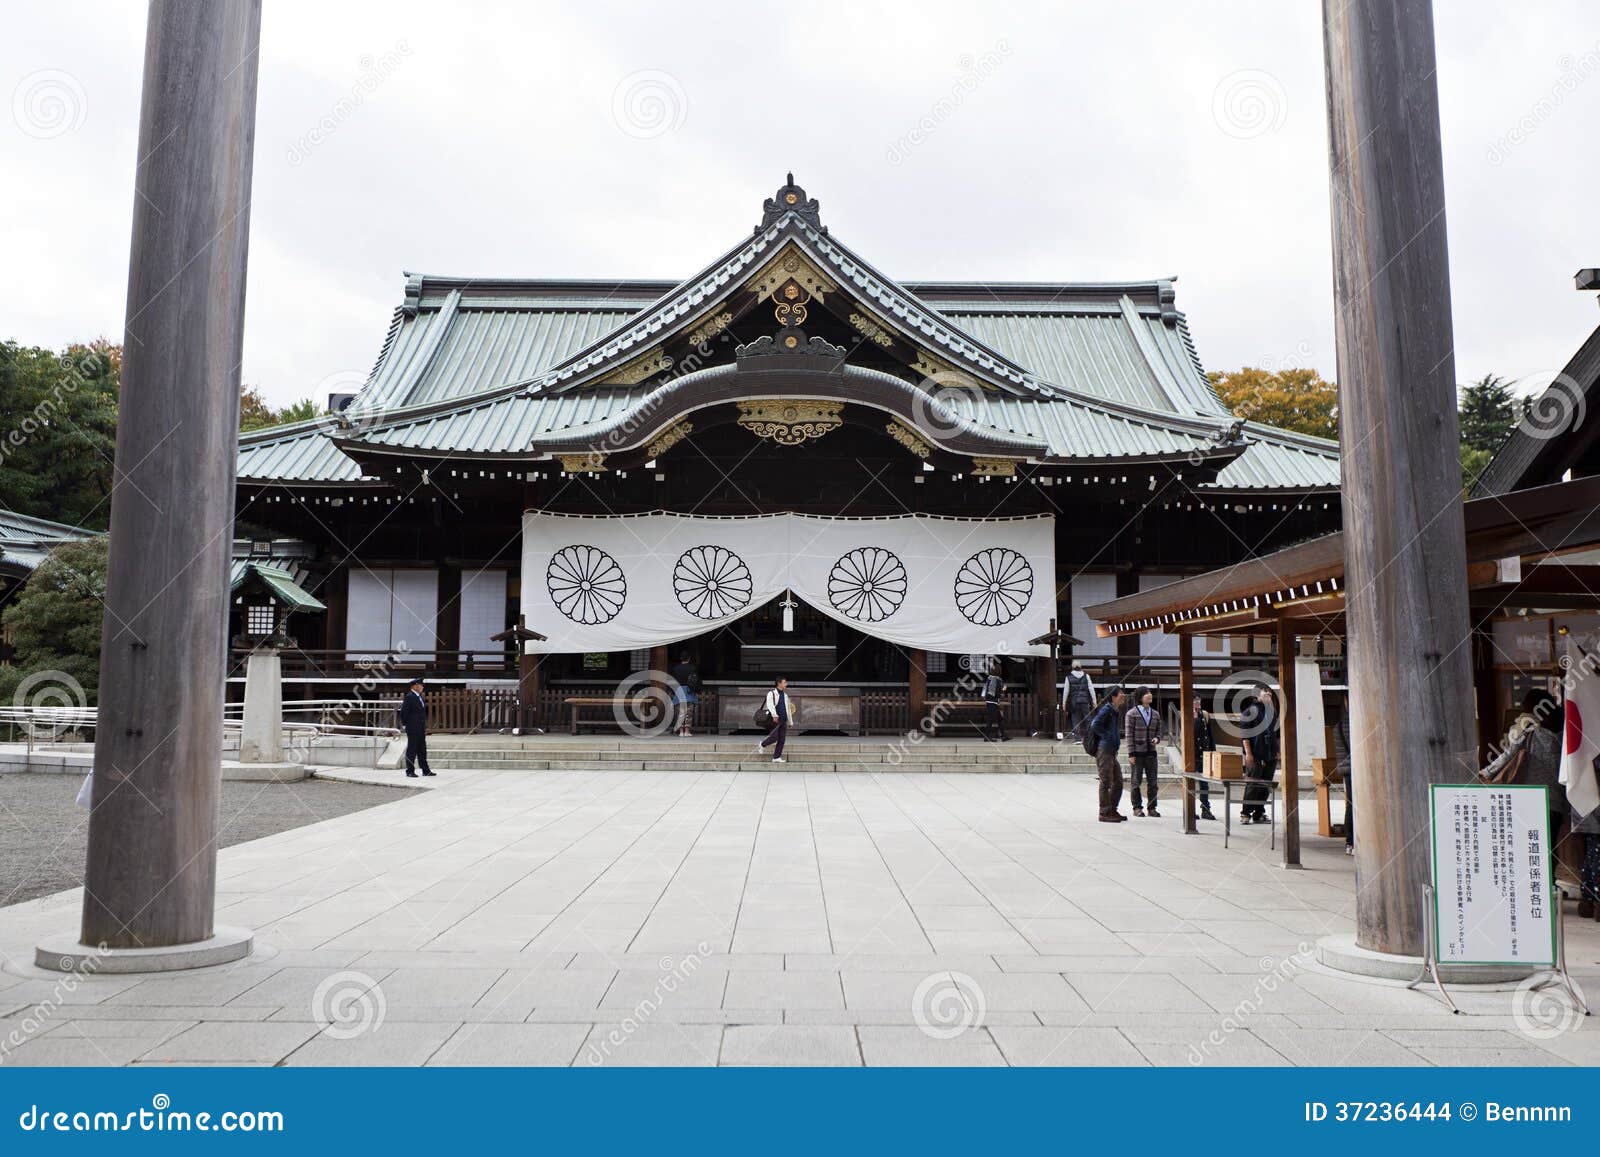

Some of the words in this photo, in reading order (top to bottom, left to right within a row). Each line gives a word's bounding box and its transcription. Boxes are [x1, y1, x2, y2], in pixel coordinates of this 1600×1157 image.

[1528, 829, 1543, 919] 報道関係者各位
